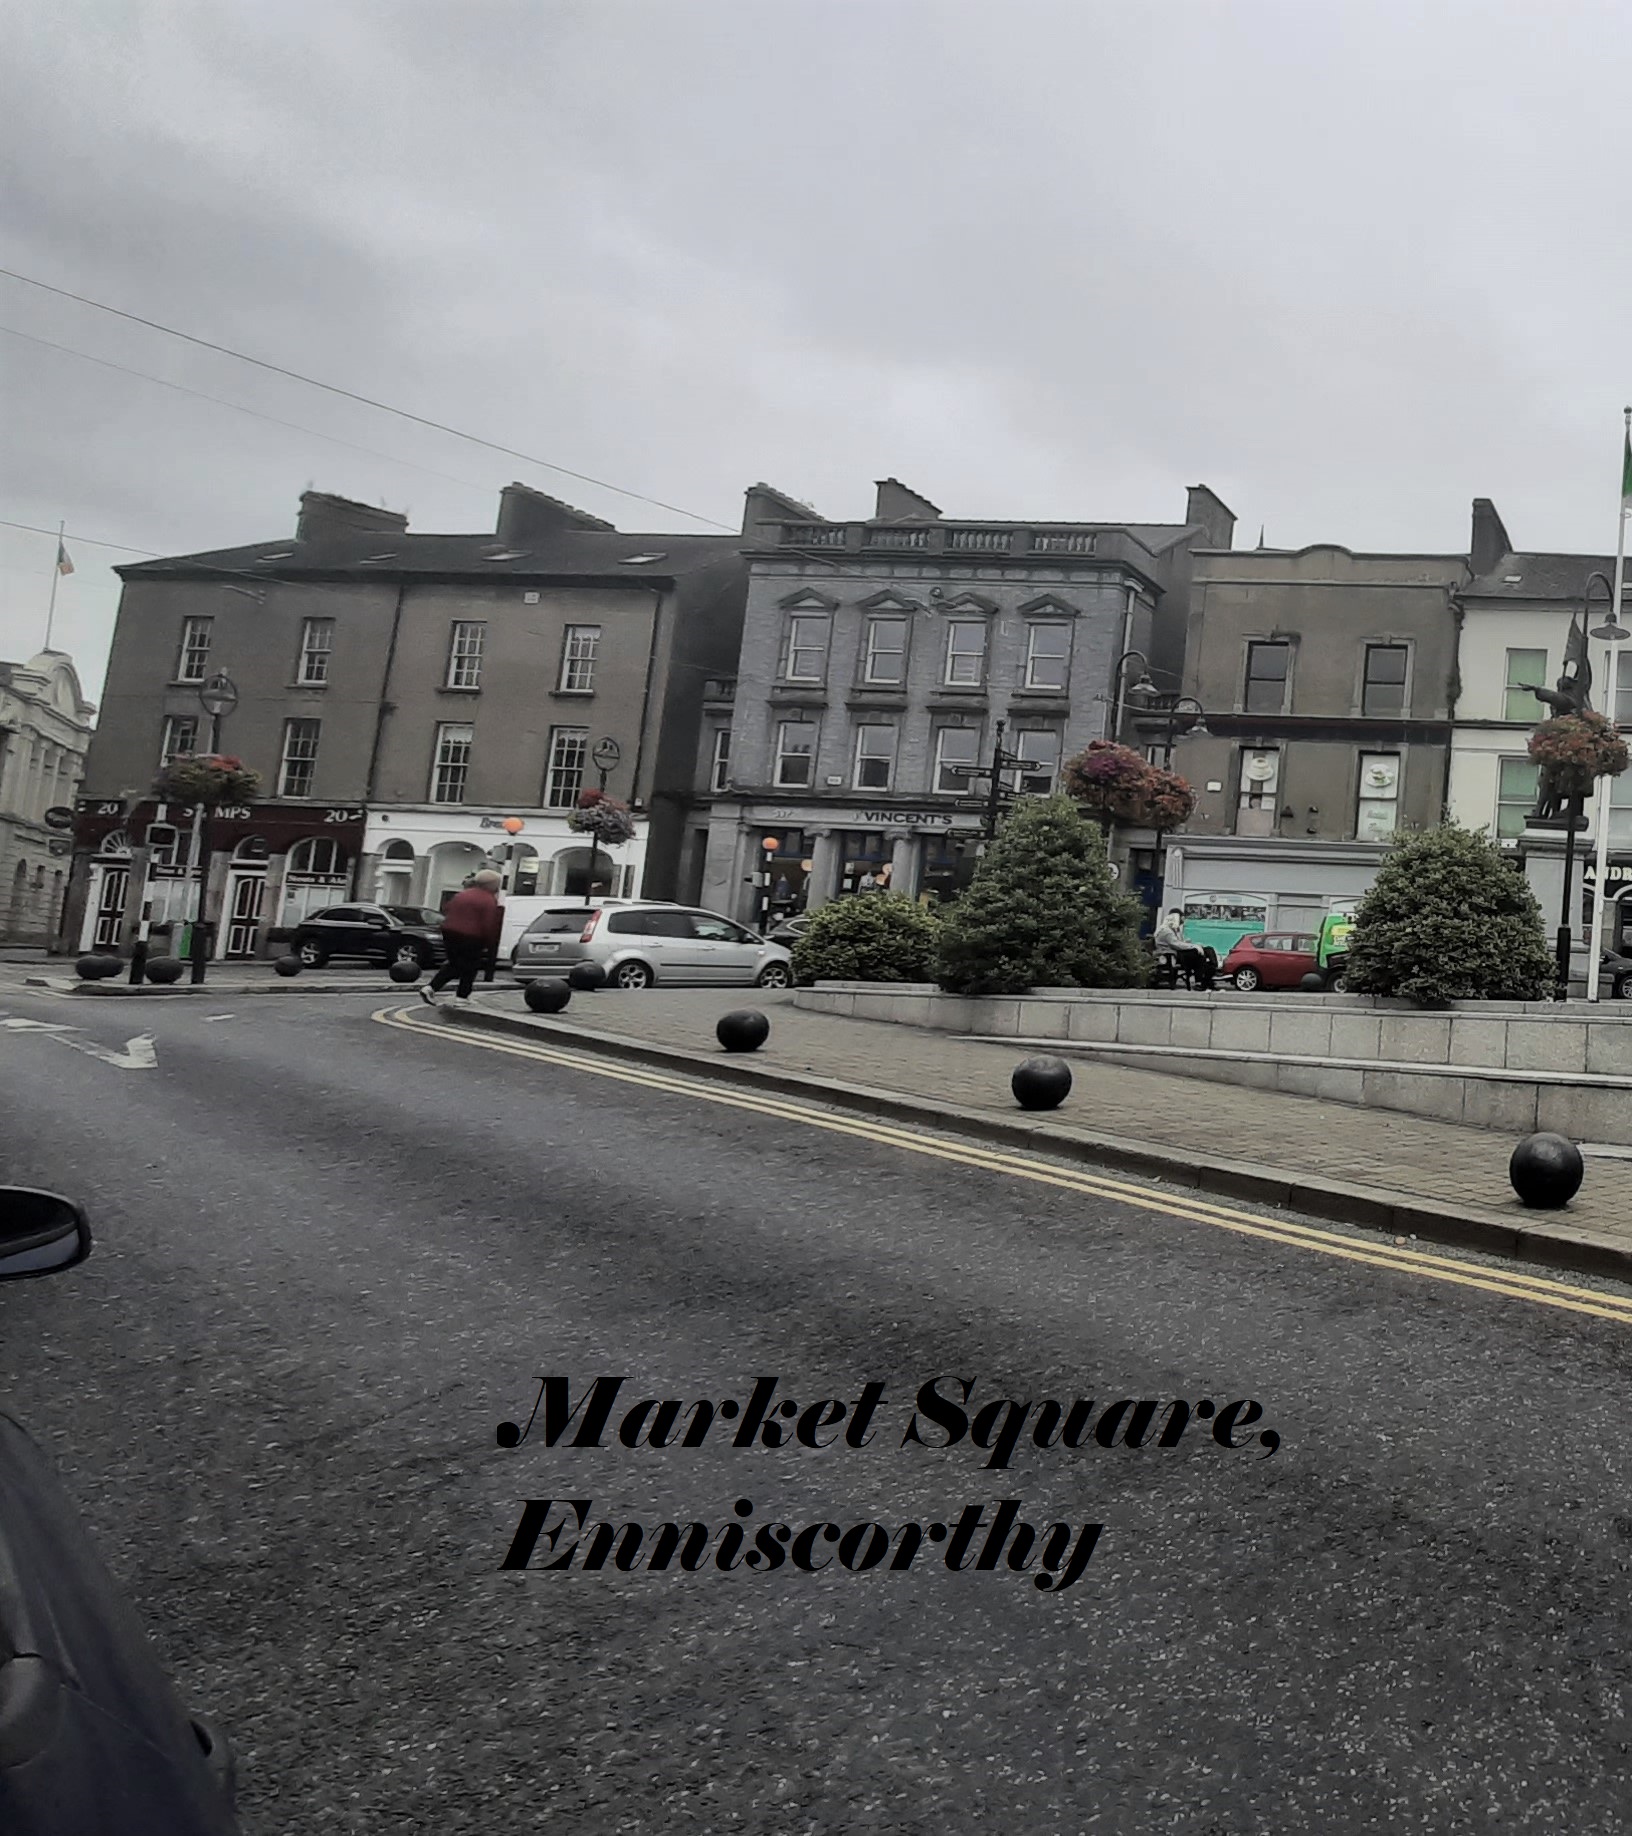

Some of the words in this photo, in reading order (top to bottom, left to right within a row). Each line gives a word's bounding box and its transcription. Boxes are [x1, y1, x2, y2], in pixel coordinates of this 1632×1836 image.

[98, 802, 119, 815] 20
[182, 806, 251, 820] SMPS
[323, 809, 348, 823] 20
[864, 810, 953, 825] VINCENT'S
